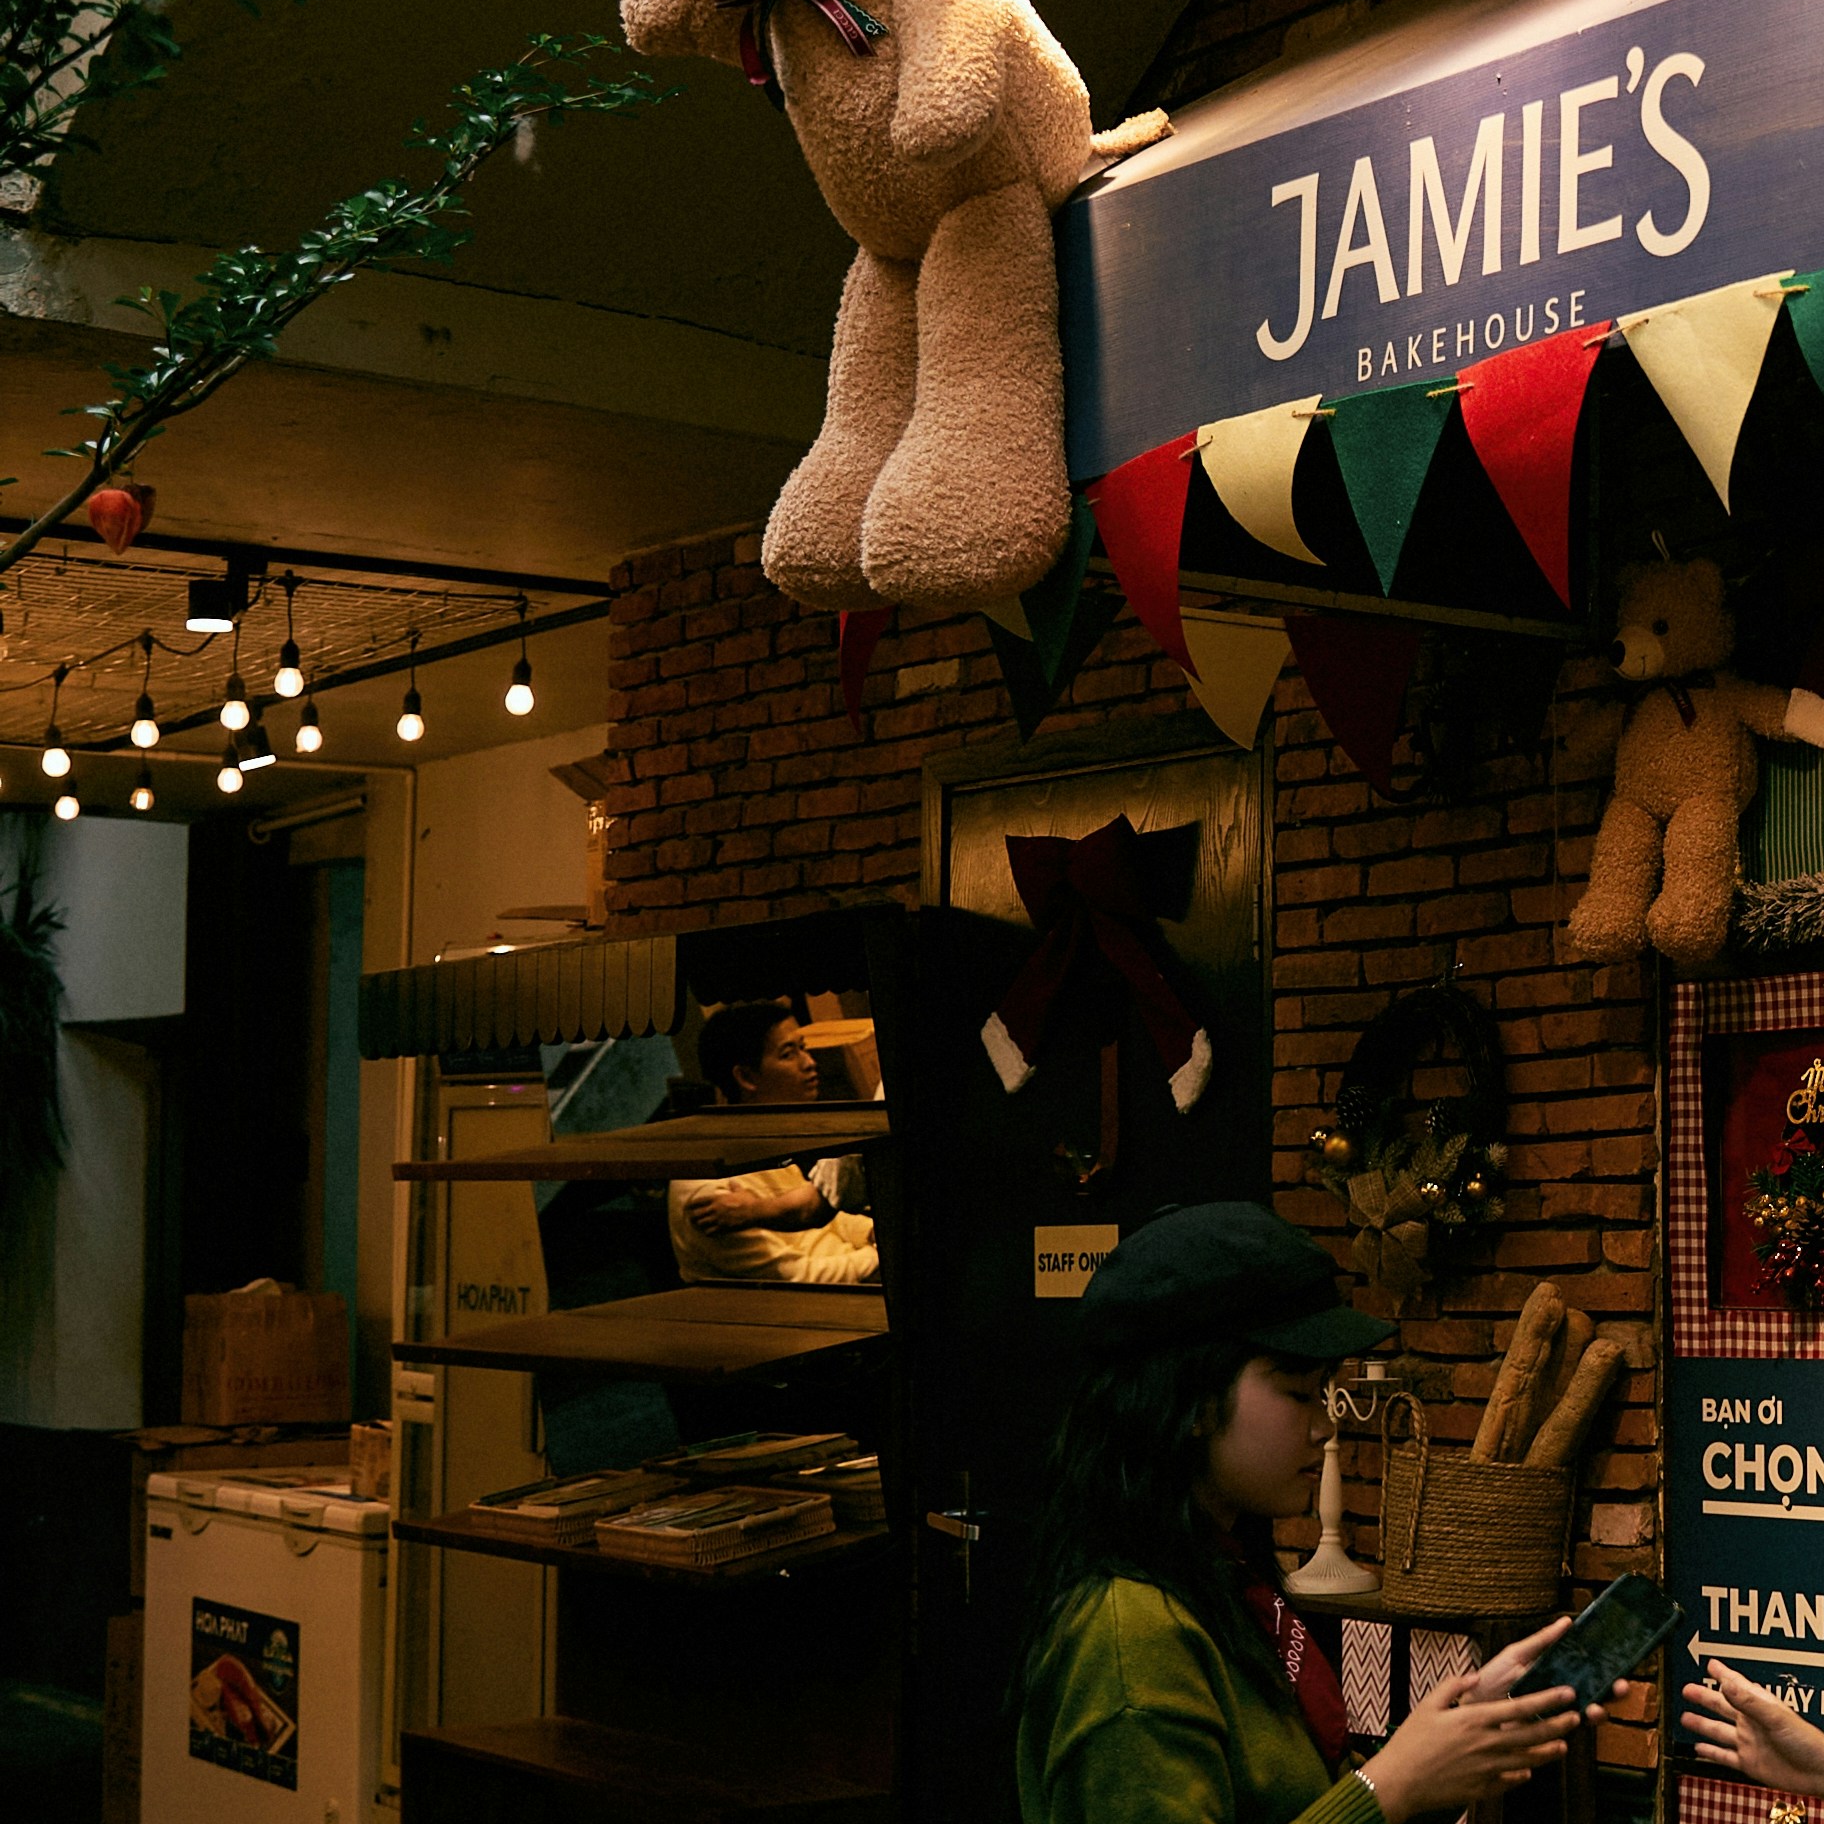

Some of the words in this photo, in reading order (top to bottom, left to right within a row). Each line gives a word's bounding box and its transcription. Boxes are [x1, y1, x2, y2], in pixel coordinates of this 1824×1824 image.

[833, 9, 858, 39] GUCCI
[1256, 46, 1711, 361] JAMIE'S
[1357, 289, 1586, 382] BAKEHOUSE
[1038, 1252, 1075, 1272] STAFF
[1701, 1398, 1751, 1430] BẠN
[1757, 1394, 1783, 1425] ƠI
